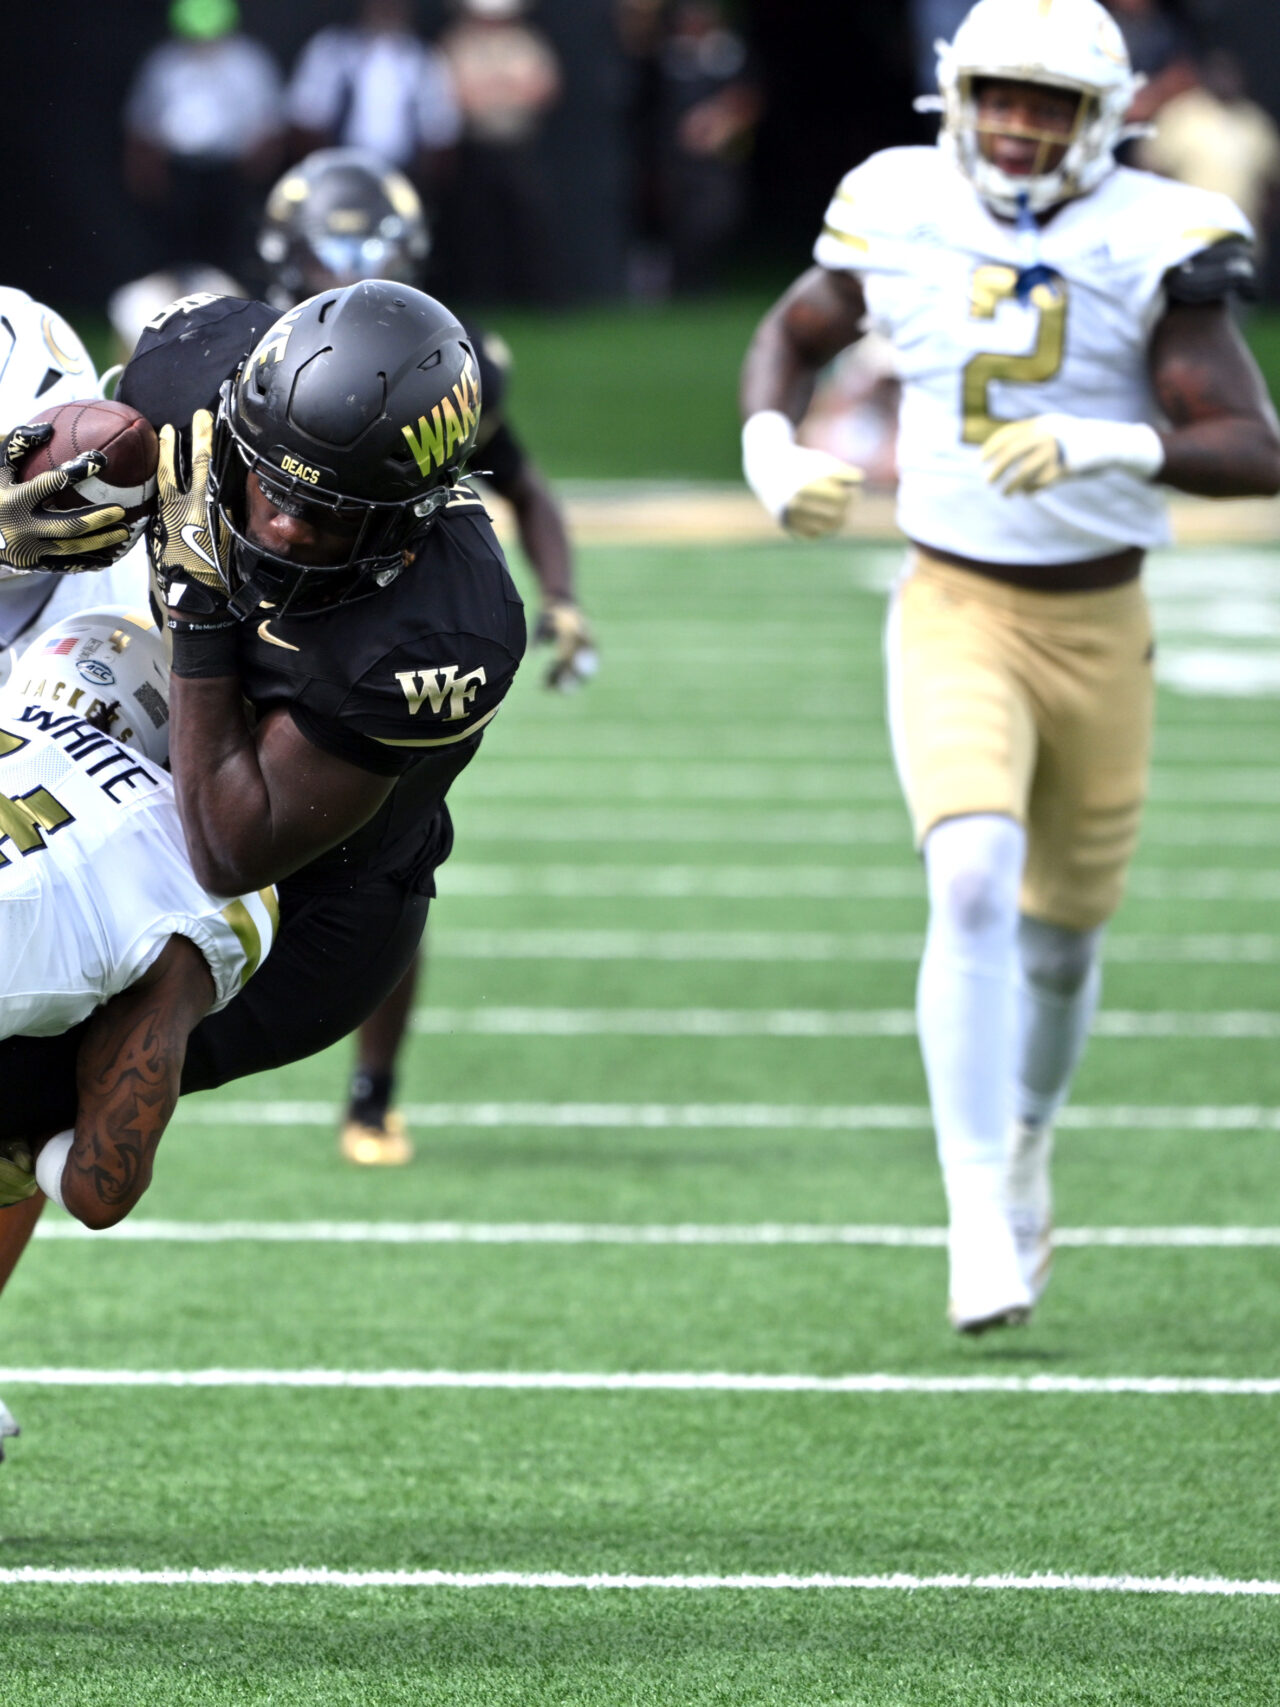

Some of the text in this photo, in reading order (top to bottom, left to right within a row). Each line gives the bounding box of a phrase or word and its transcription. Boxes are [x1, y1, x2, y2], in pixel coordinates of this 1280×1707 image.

[961, 265, 1067, 446] 2
[281, 454, 321, 486] DEACS
[86, 664, 113, 682] ACC
[394, 664, 487, 723] WF
[16, 704, 159, 804] WHITE
